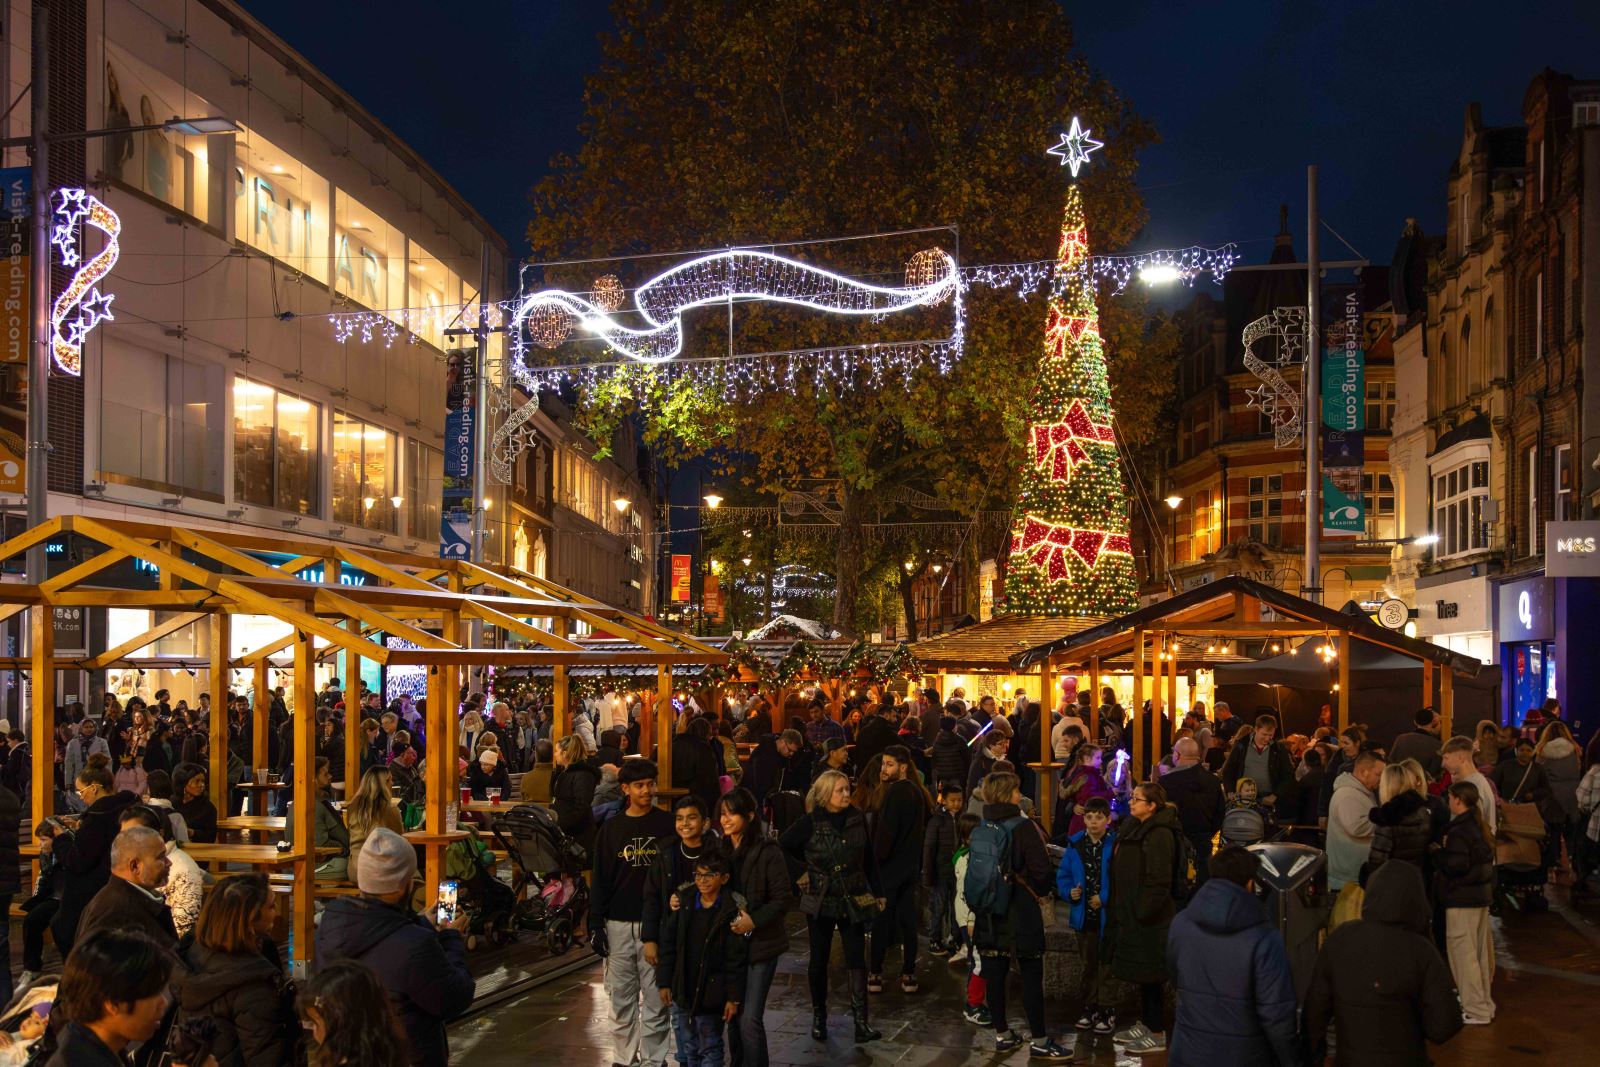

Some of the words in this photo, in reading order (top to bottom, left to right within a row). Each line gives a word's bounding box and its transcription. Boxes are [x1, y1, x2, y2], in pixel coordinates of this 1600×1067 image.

[5, 179, 26, 360] visit-reading.com
[1341, 291, 1360, 430] visit-reading.com
[457, 356, 473, 477] visit-reading.com
[1557, 537, 1596, 553] M&S
[1385, 603, 1402, 624] 3
[1436, 599, 1458, 619] Three
